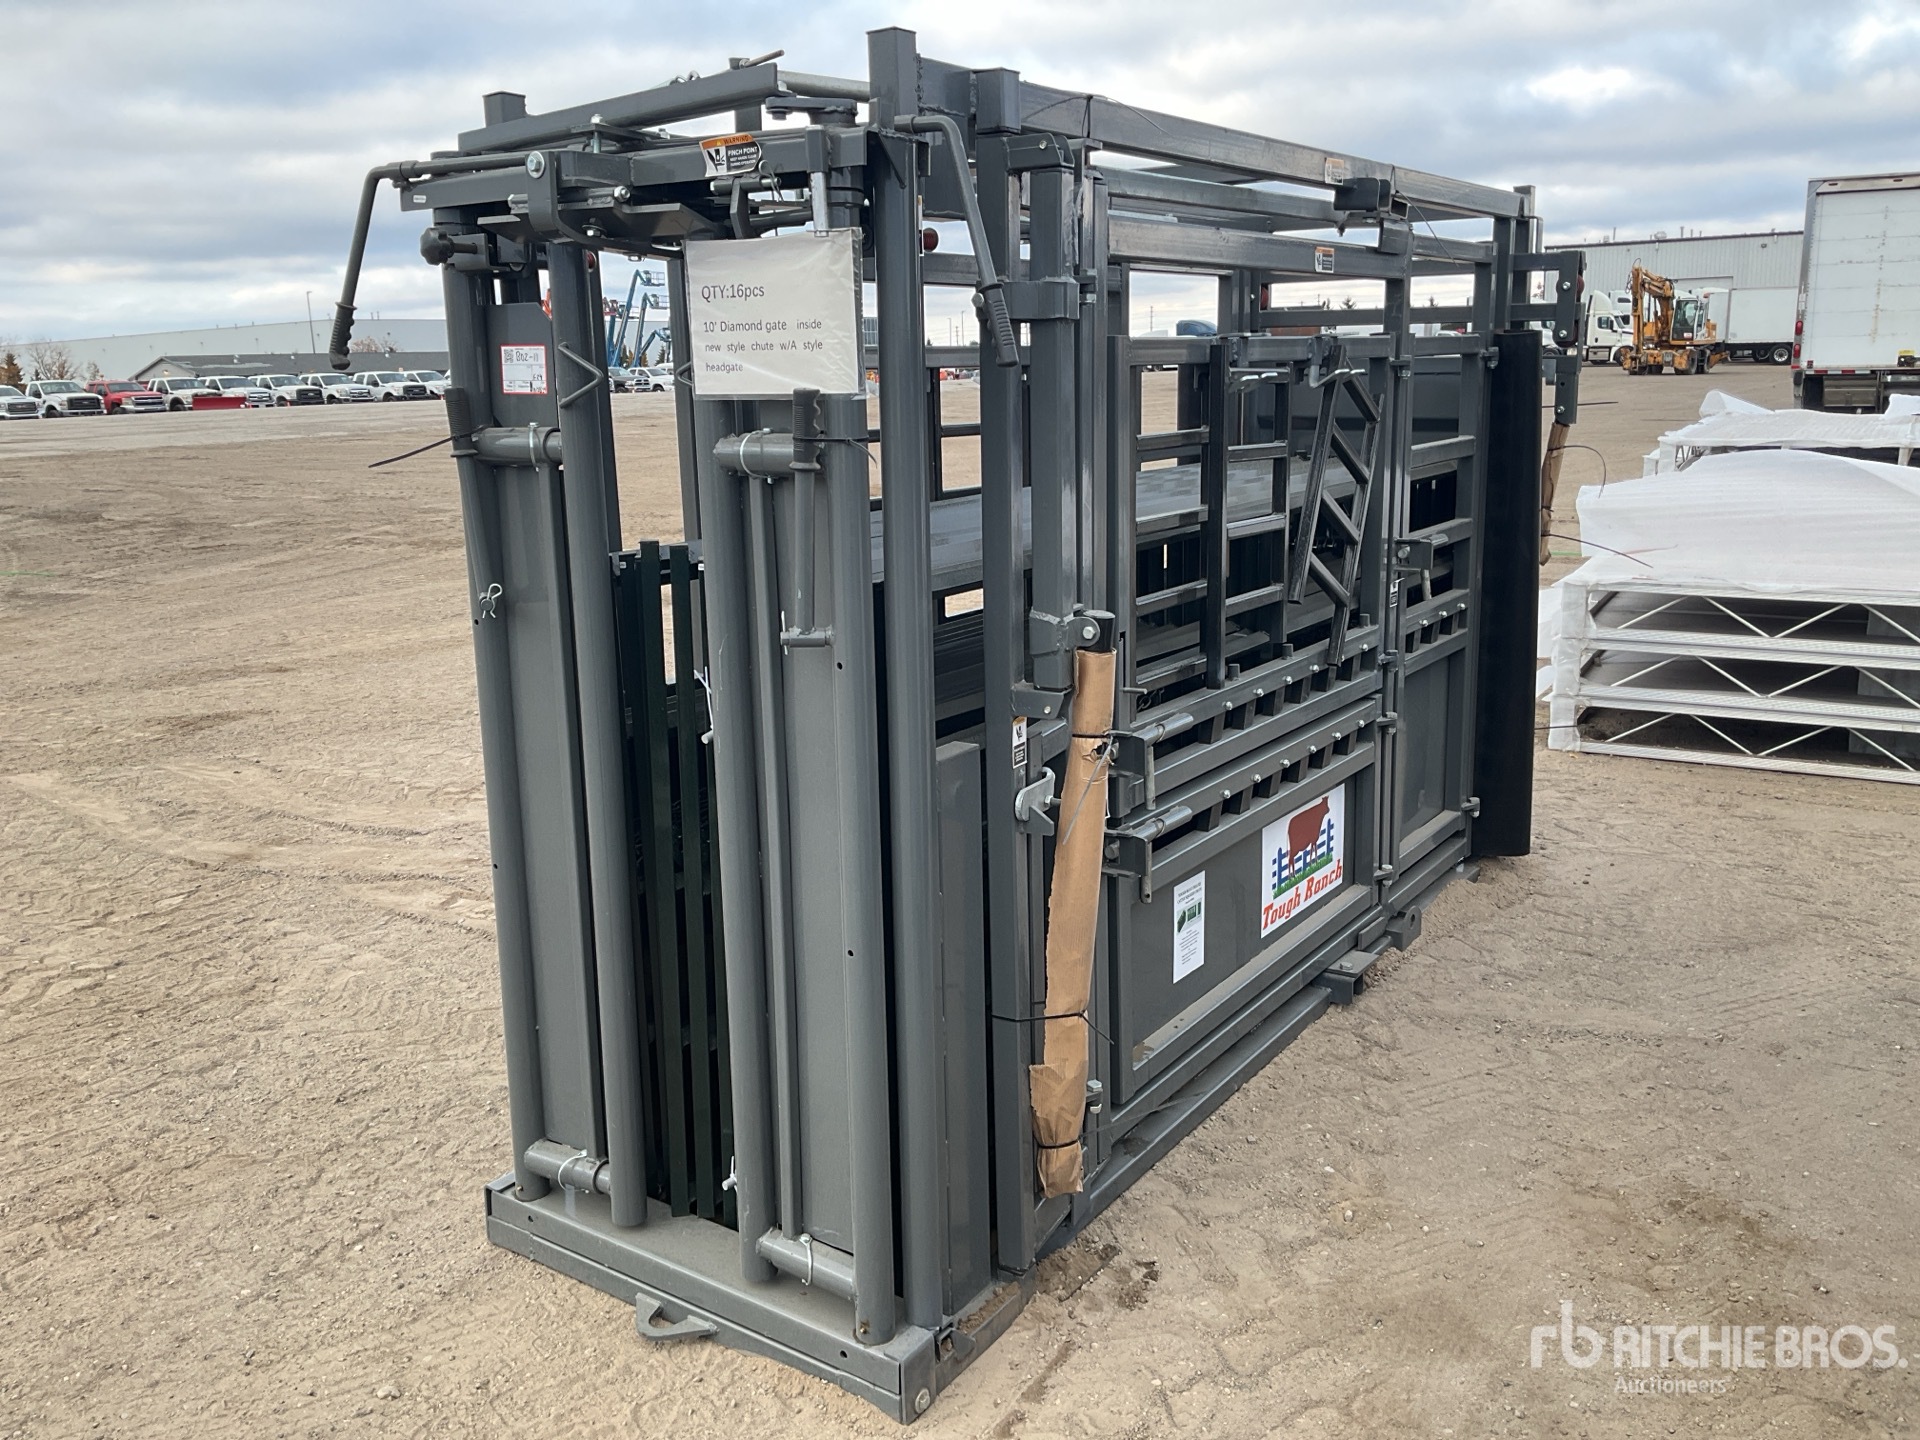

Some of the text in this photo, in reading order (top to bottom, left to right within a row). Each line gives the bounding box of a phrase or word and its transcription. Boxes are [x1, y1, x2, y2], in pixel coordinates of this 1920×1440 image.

[723, 135, 749, 145] WARNING
[727, 146, 758, 157] PINCH POINT
[701, 284, 765, 302] QTY:16pcs
[703, 319, 822, 333] 10' Diamond gate inside
[705, 339, 823, 354] new style chute w/A style
[705, 362, 743, 374] headgate
[1262, 859, 1343, 931] Tough Ranch
